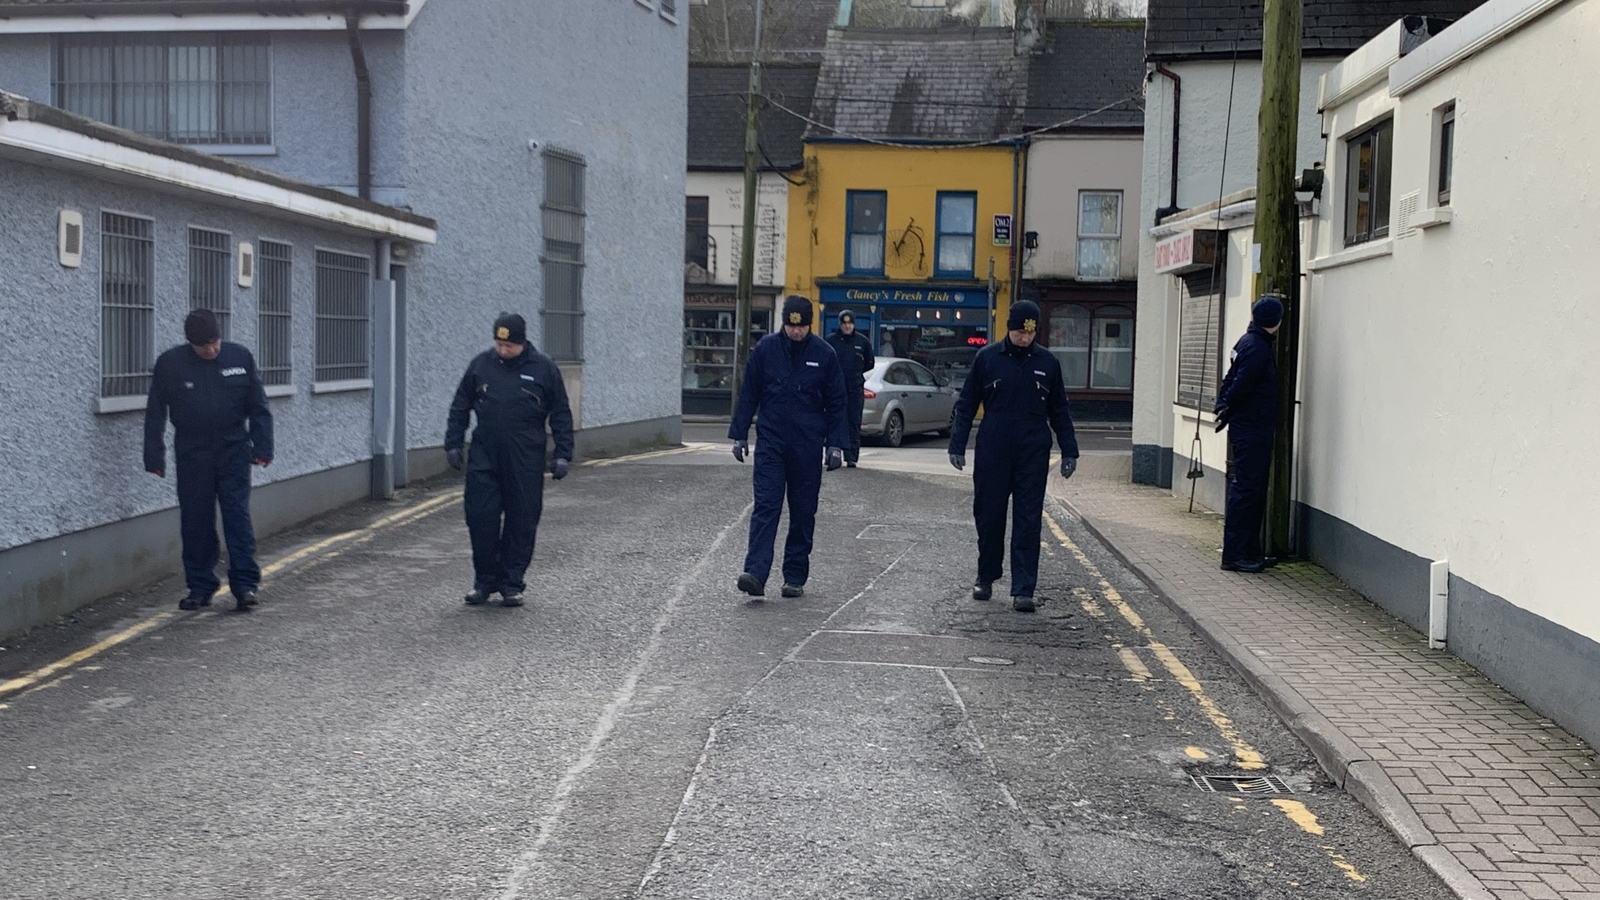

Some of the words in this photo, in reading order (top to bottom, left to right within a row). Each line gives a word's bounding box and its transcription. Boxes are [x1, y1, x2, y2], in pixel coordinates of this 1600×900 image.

[846, 288, 889, 302] Clancy's
[893, 290, 922, 301] Fresh
[927, 291, 950, 302] Fish
[967, 337, 987, 345] OPEN
[222, 367, 246, 376] GARDA
